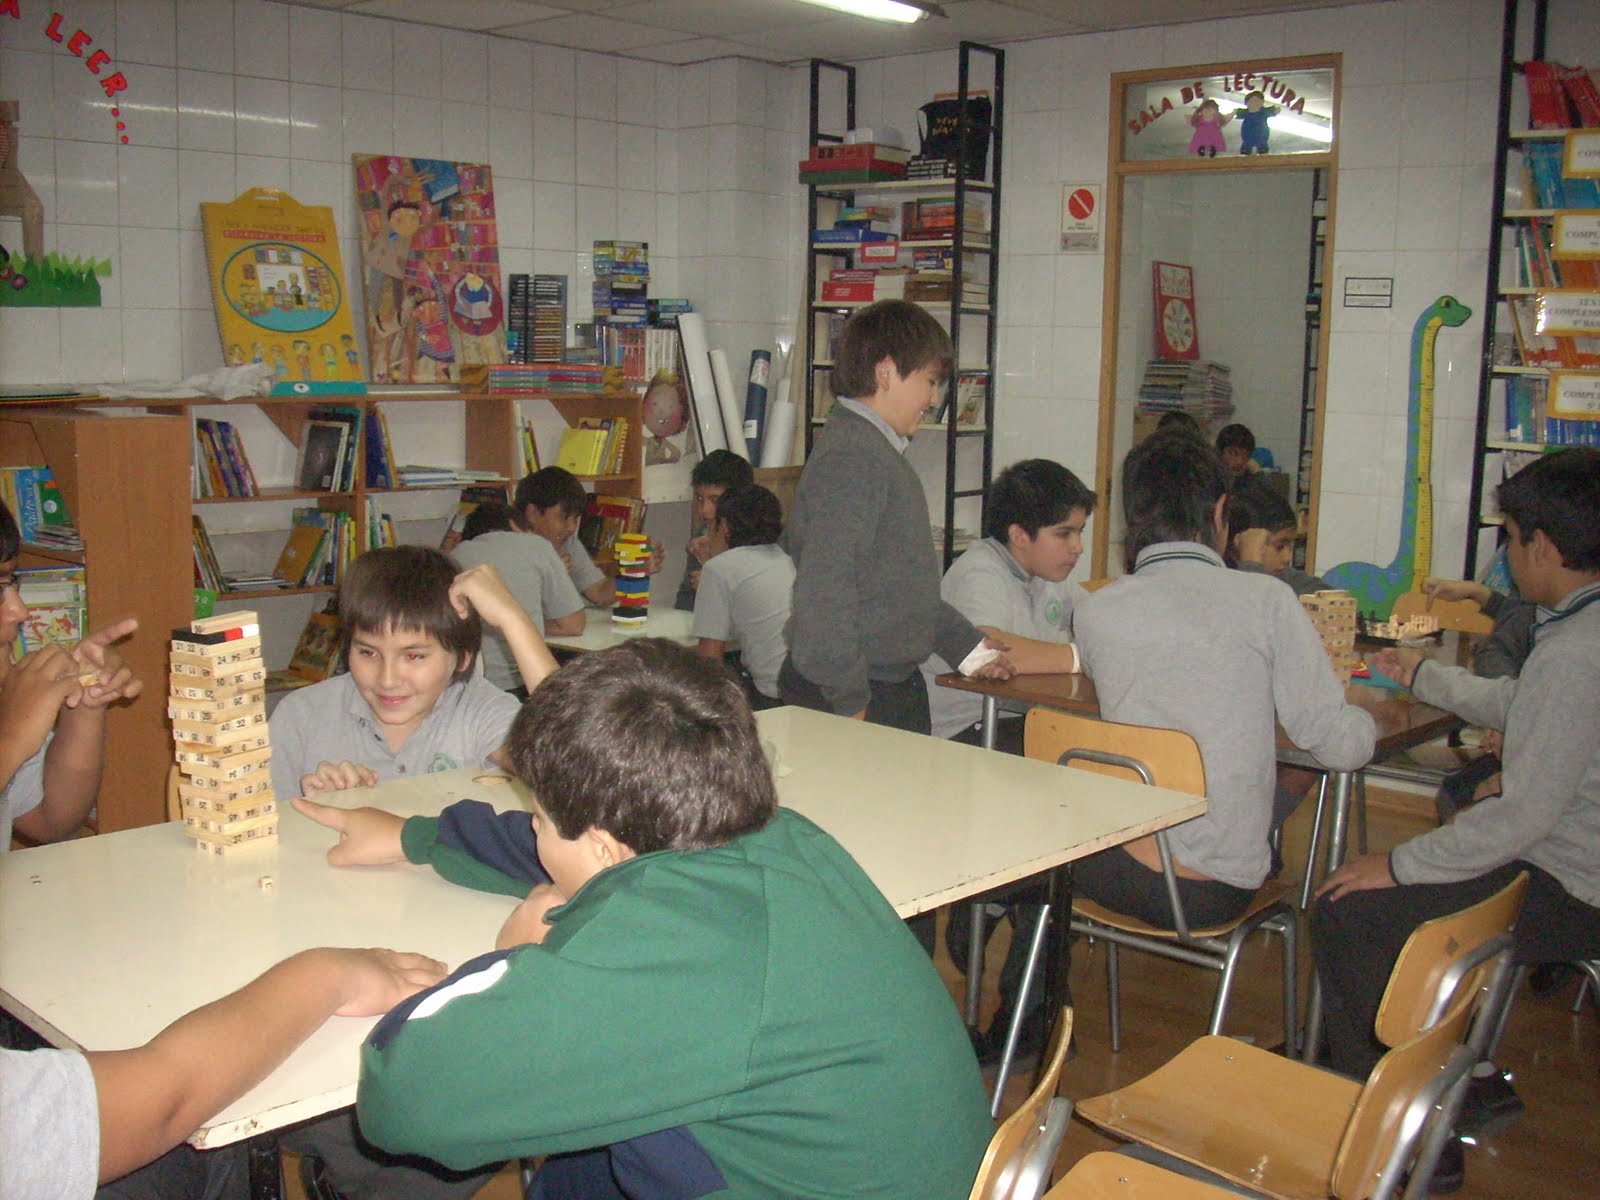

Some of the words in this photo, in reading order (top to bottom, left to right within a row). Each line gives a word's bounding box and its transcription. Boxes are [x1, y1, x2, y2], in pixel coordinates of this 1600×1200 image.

[1127, 96, 1174, 136] SALA
[1180, 82, 1205, 104] DE
[1224, 73, 1306, 116] LECTURA
